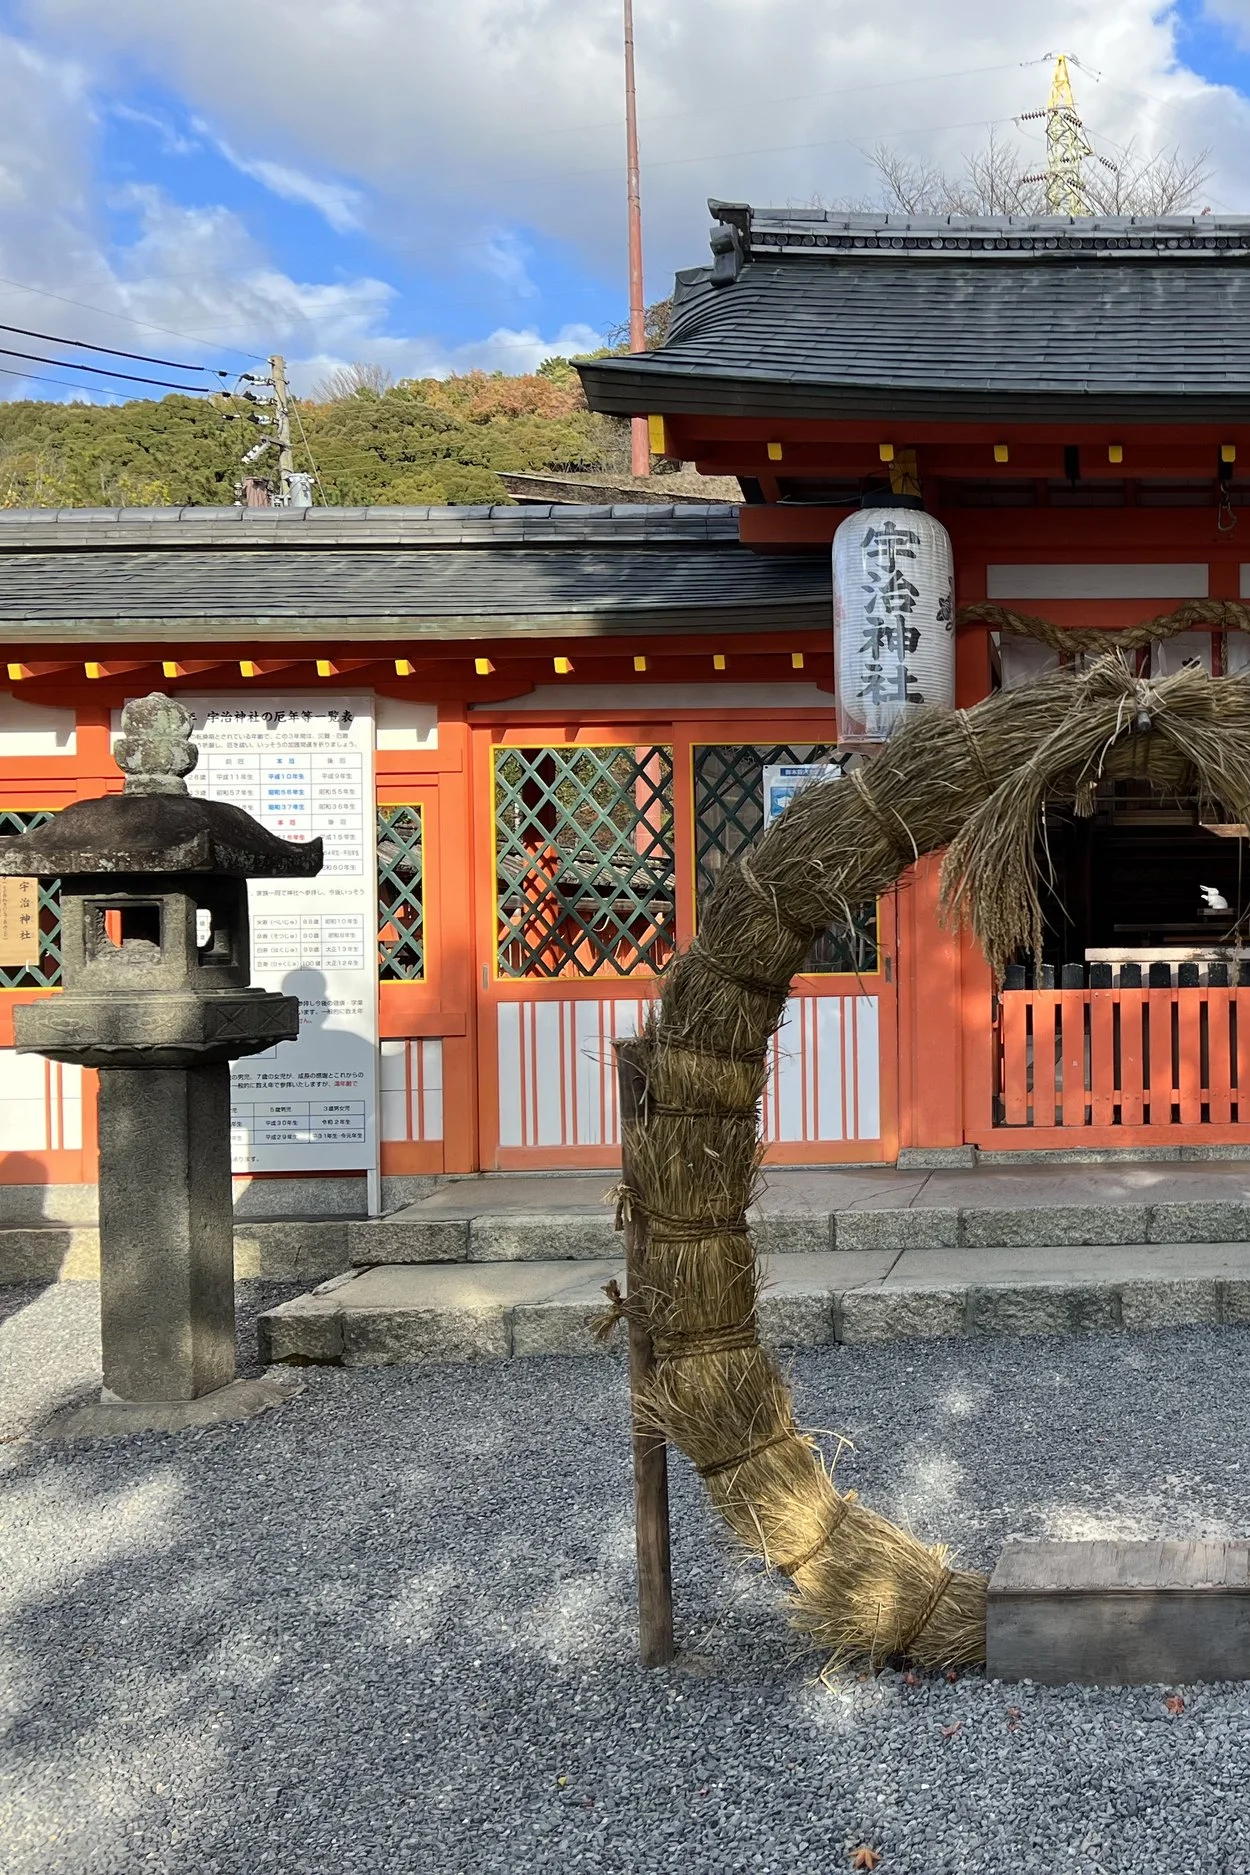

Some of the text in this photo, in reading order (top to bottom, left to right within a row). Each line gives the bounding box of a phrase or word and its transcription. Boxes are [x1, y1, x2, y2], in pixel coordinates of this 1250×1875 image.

[856, 520, 924, 706] 宇治神社
[207, 709, 354, 724] 宇治神社の厄年等一覧表
[19, 881, 32, 941] 宇治神社
